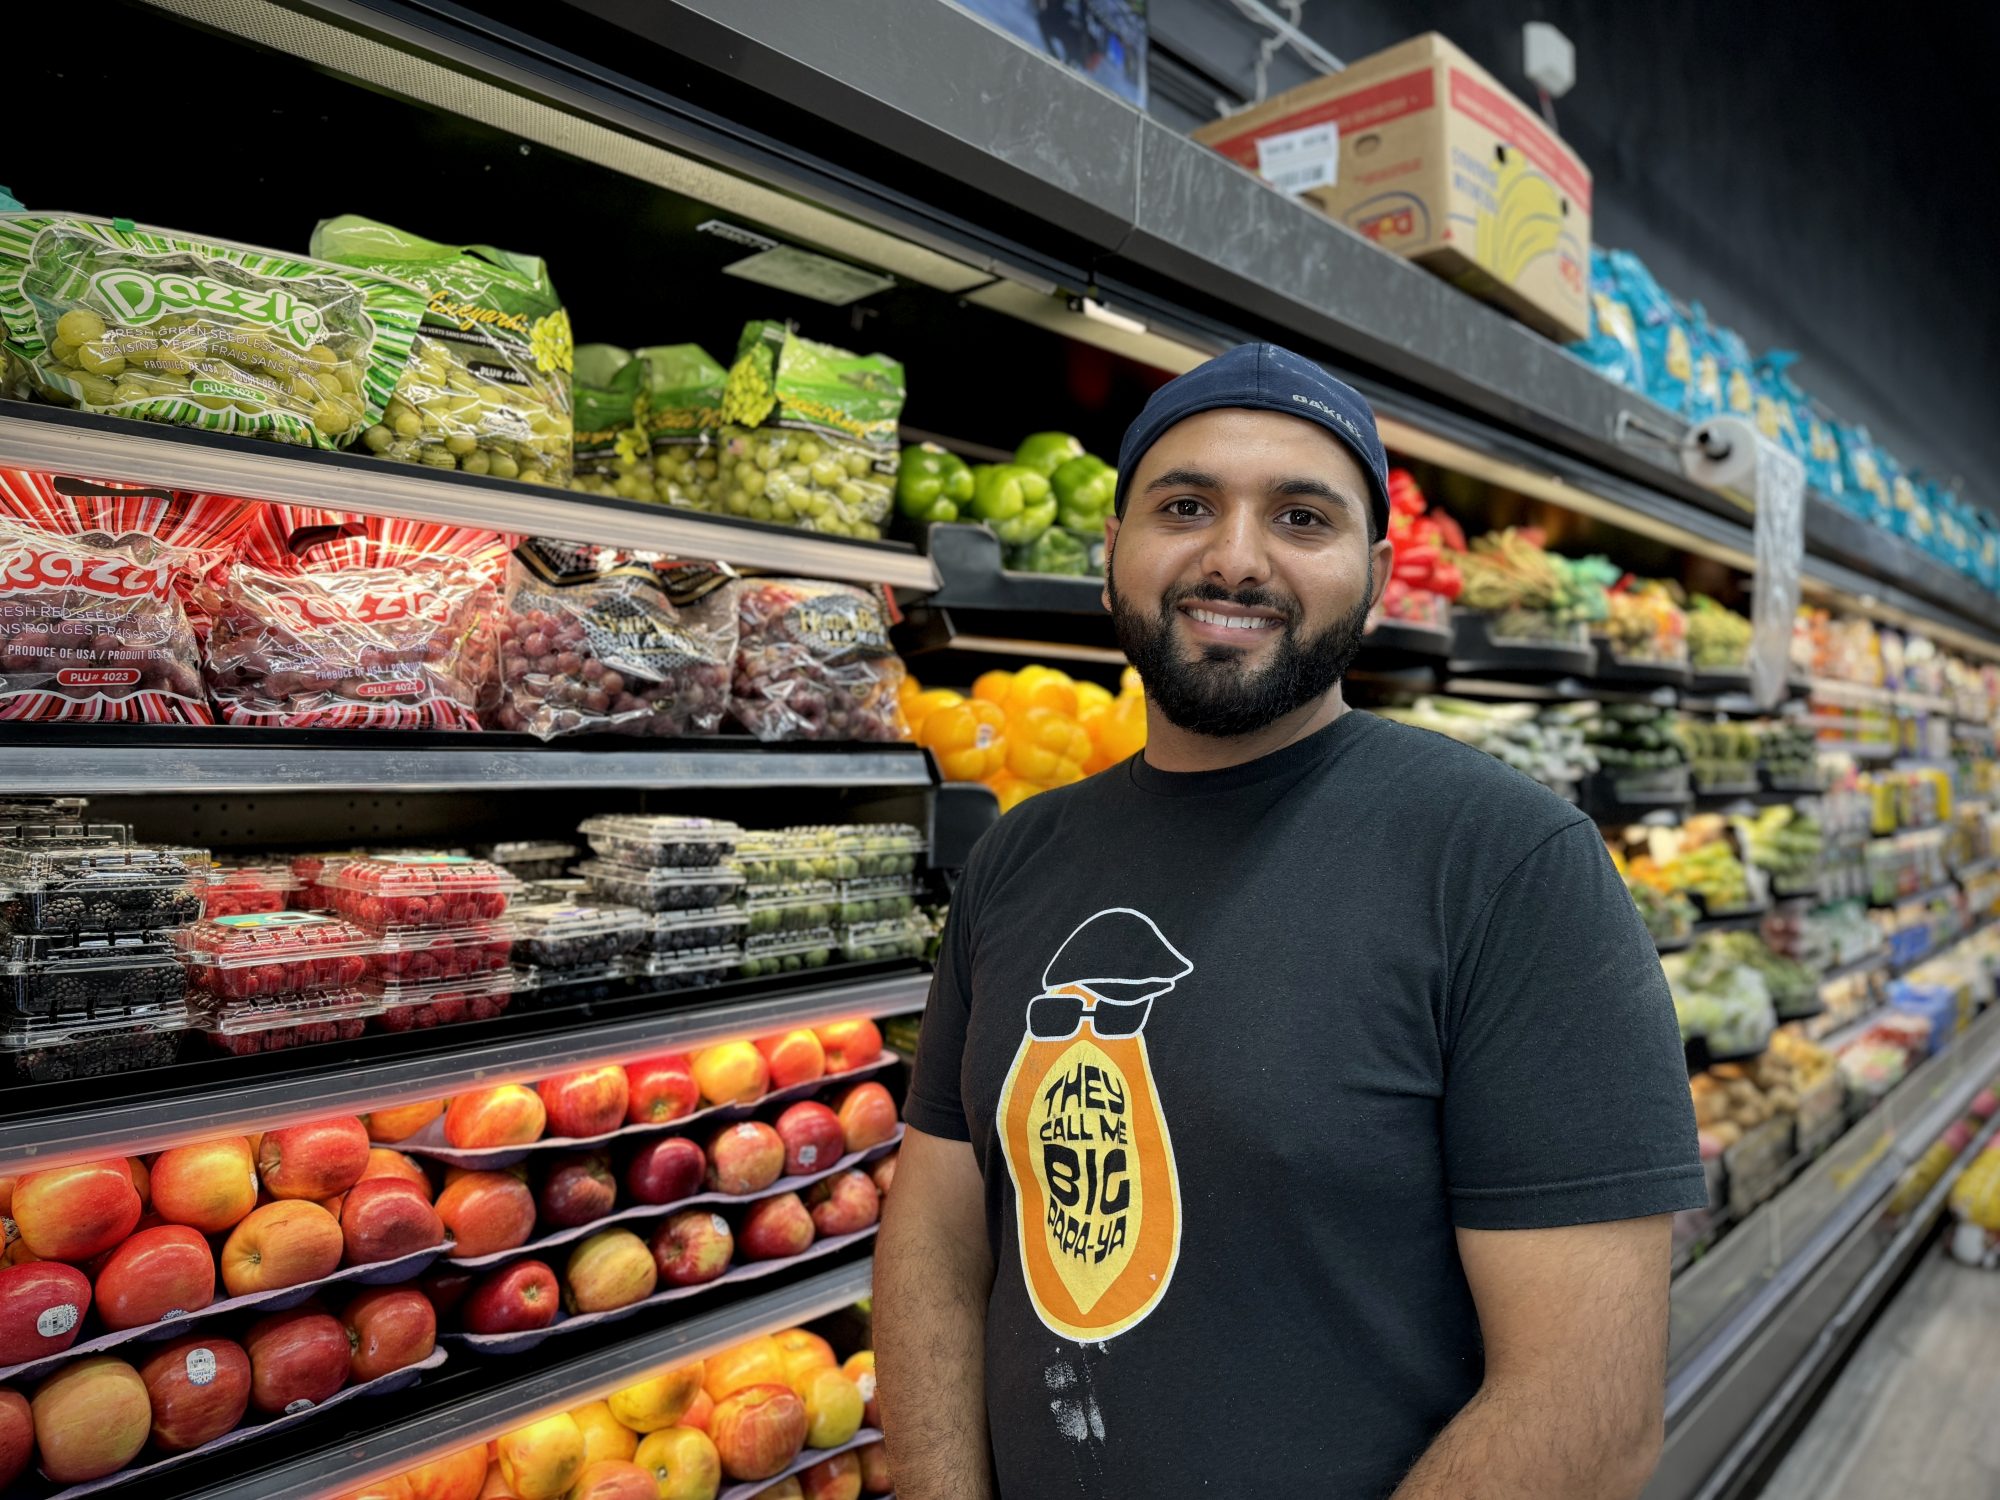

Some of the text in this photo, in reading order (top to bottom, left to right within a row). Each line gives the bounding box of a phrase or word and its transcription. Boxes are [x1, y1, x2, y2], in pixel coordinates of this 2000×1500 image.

[94, 270, 323, 350] Dazzle
[158, 326, 206, 340] GREEN
[210, 329, 276, 353] SEEDLESS
[102, 340, 159, 359] RAISINS
[211, 344, 248, 361] FRAIS
[250, 354, 286, 373] SANS
[143, 360, 185, 370] PRODUCE
[202, 362, 219, 374] USA
[41, 606, 72, 619] RED
[25, 623, 93, 635] ROUGES
[97, 625, 131, 639] FRAIS
[132, 629, 166, 640] SANS
[8, 645, 56, 658] PRODUCE
[60, 648, 73, 659] OF
[76, 649, 96, 660] USA
[108, 650, 144, 660] PRODUIT
[70, 672, 129, 682] PLU# 4023
[315, 668, 353, 680] PRODUCE
[354, 667, 366, 677] OF
[367, 664, 382, 674] USA
[367, 685, 393, 694] PLU#
[1043, 1062, 1125, 1117] THEY
[1040, 1114, 1128, 1145] CALL ME
[1043, 1144, 1130, 1216] BIG
[1048, 1196, 1127, 1265] PAPA-YA
